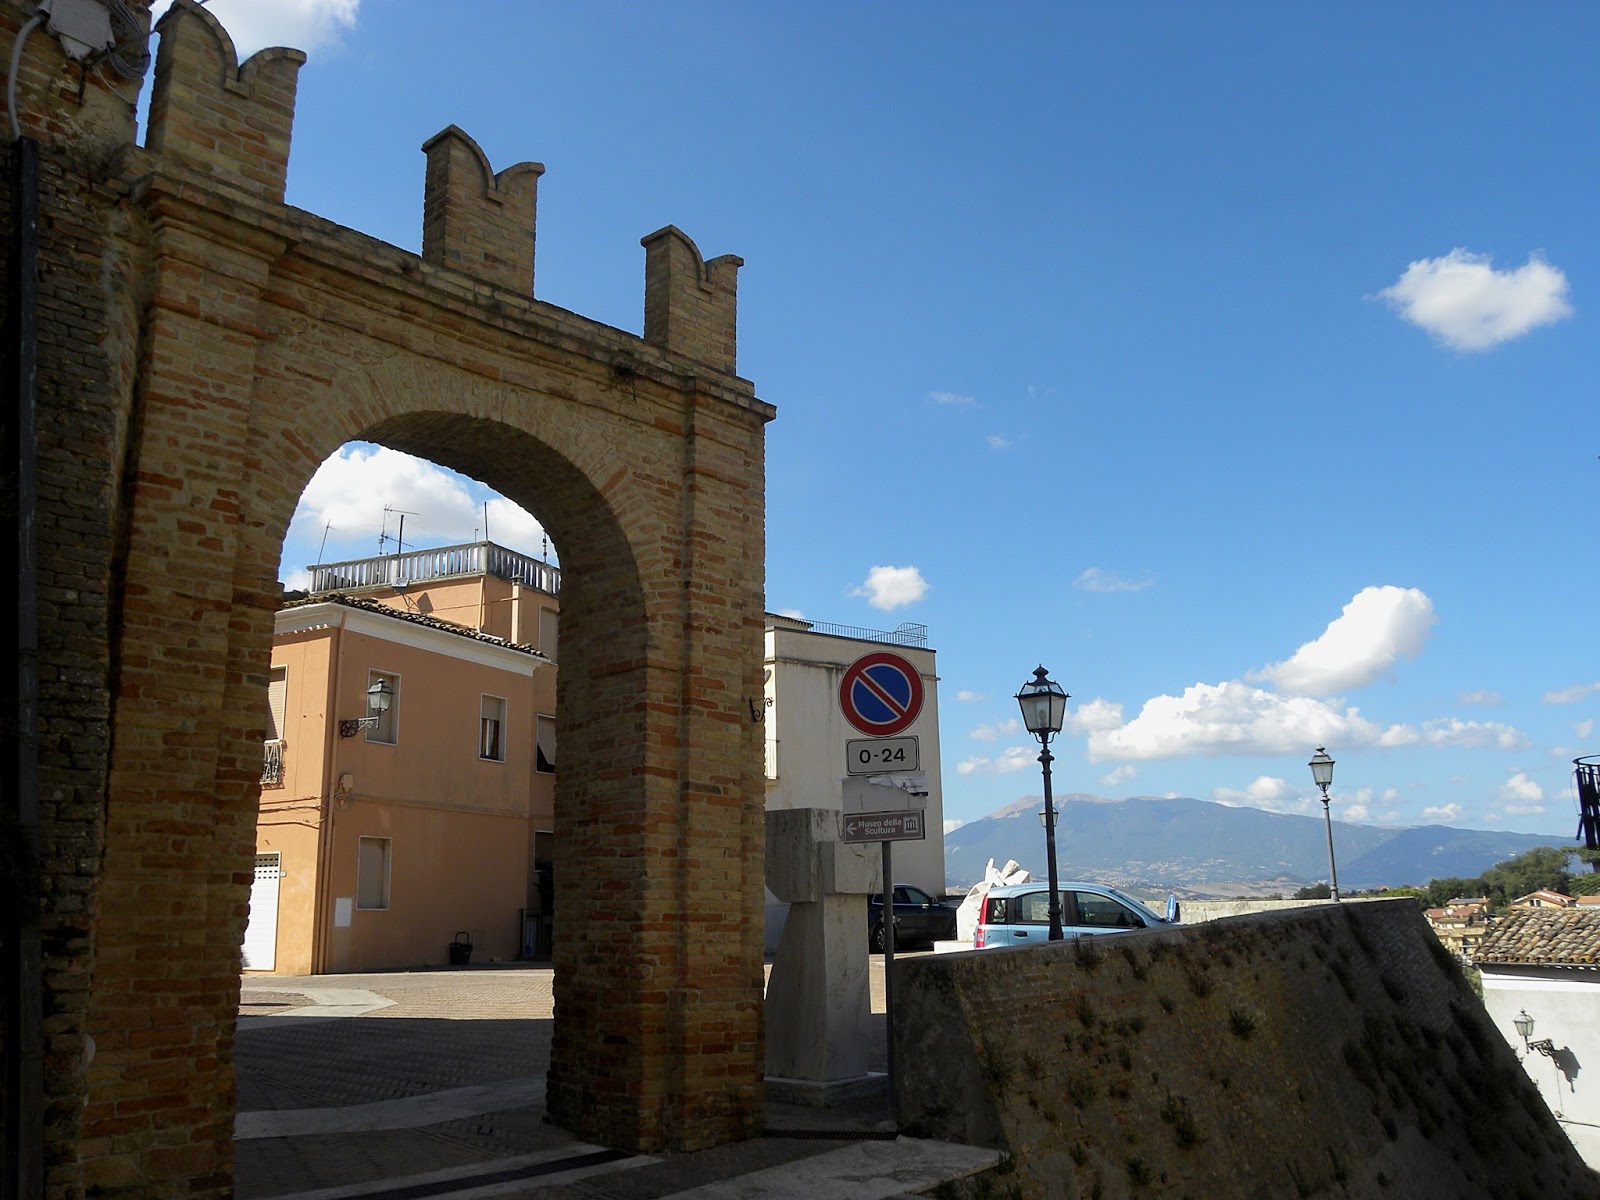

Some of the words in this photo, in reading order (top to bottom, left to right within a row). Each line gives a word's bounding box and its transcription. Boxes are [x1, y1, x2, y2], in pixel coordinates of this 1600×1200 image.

[858, 820, 882, 828] Museo
[883, 818, 902, 827] della
[864, 827, 896, 835] Scultura
